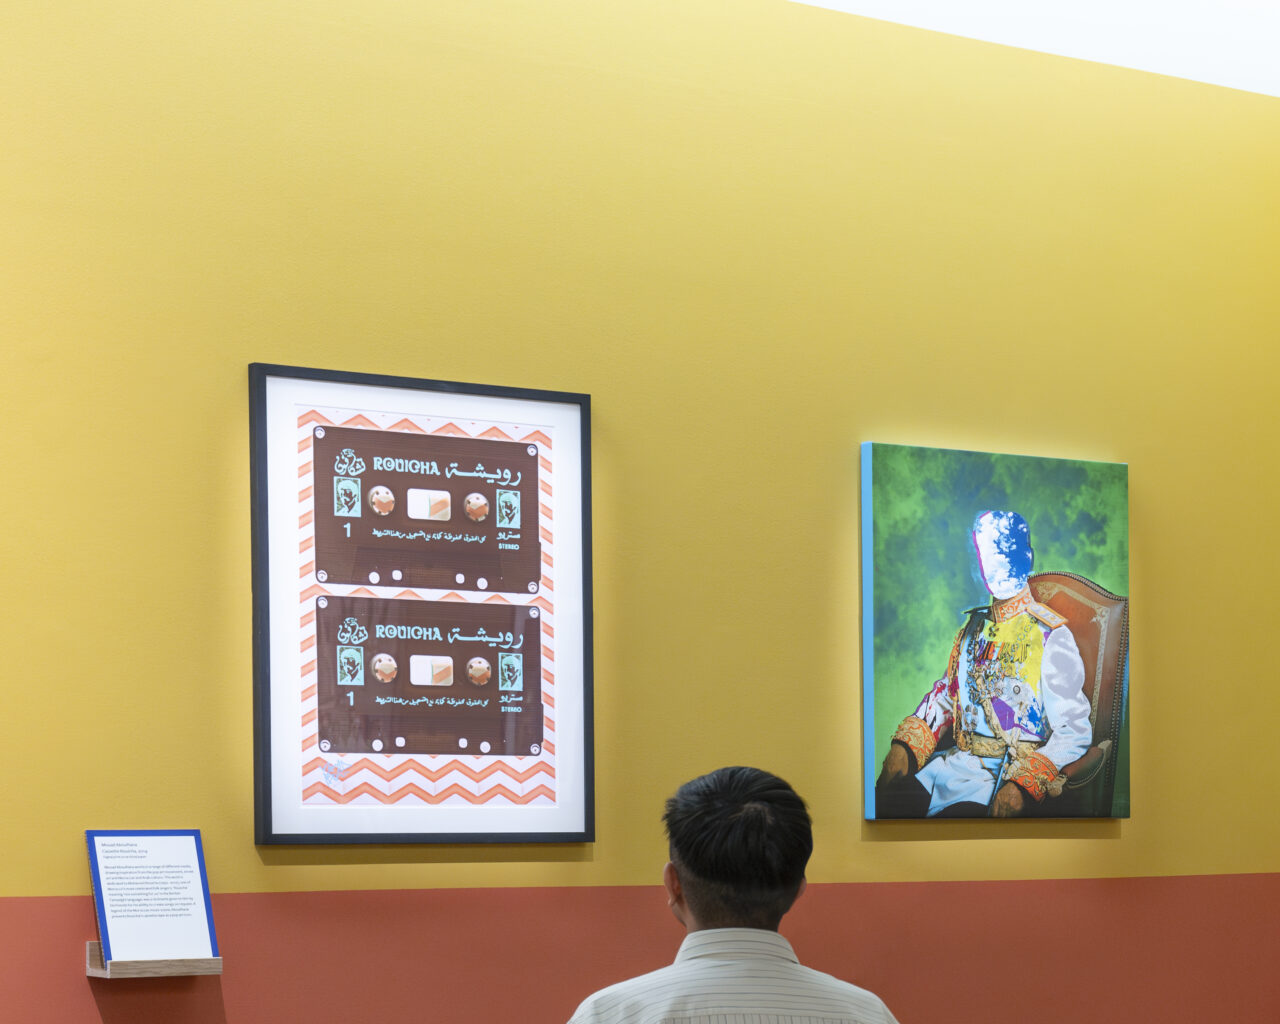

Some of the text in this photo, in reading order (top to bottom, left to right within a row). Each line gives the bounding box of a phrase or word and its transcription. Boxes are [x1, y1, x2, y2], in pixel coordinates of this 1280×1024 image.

[373, 456, 441, 476] ROUICHA
[445, 462, 522, 486] رويشة
[343, 522, 352, 538] 1
[498, 542, 520, 551] STEREO
[376, 624, 443, 642] ROUICHA
[447, 627, 524, 649] رويشة
[346, 691, 355, 707] 1
